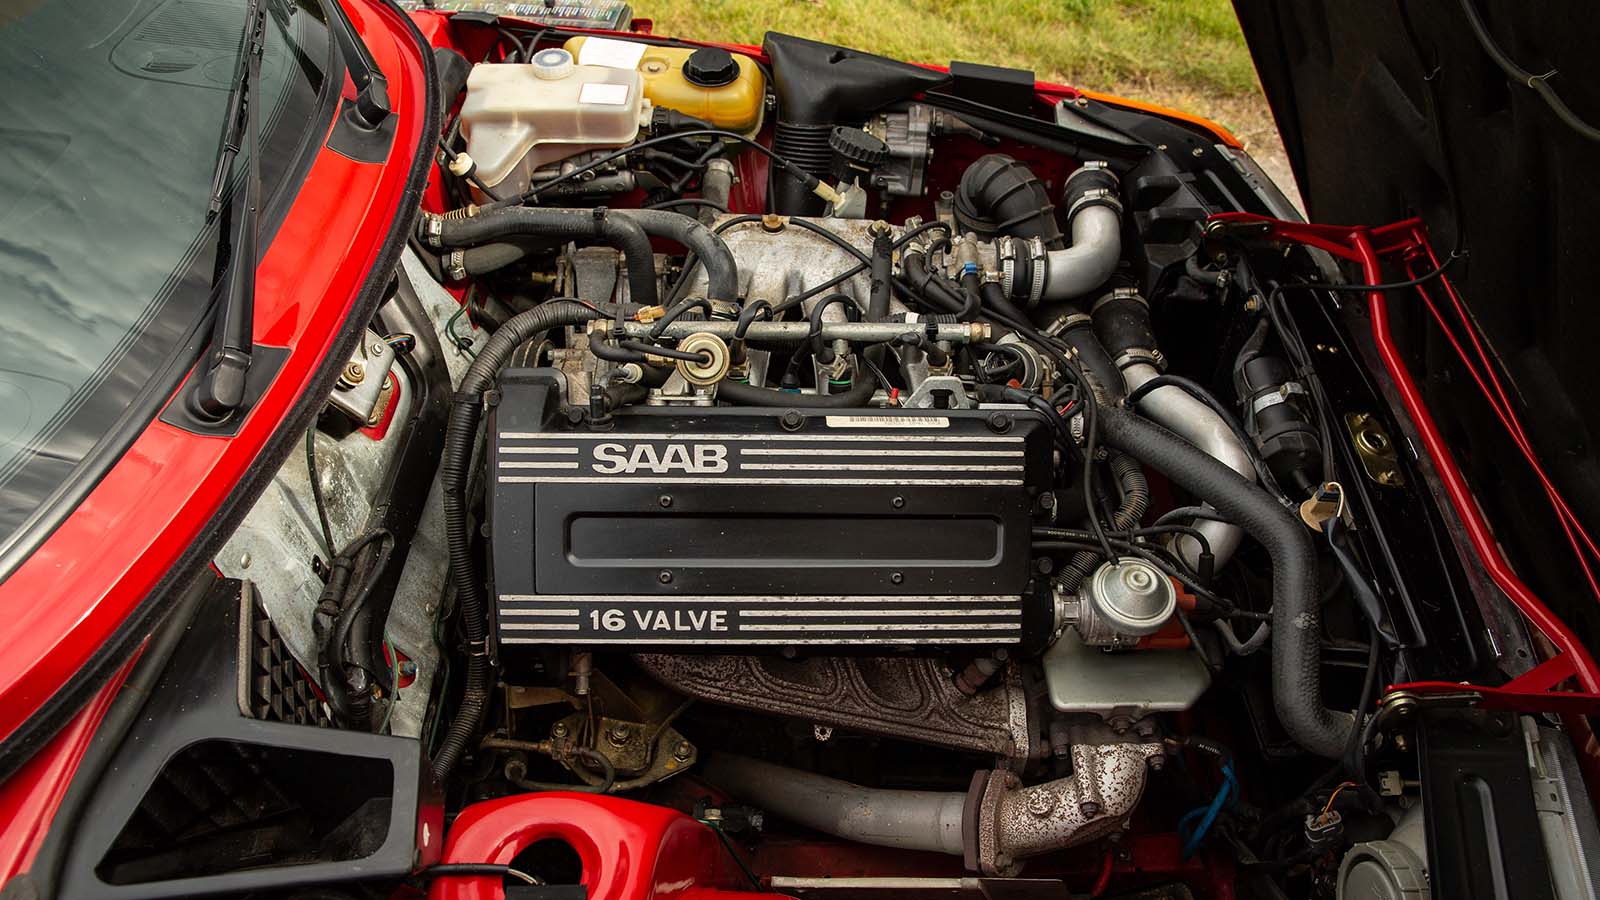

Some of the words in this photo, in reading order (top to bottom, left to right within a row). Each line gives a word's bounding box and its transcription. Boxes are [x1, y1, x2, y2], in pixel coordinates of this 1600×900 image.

[592, 443, 729, 474] SAAB
[590, 610, 626, 632] 16
[633, 610, 728, 632] VALVE
